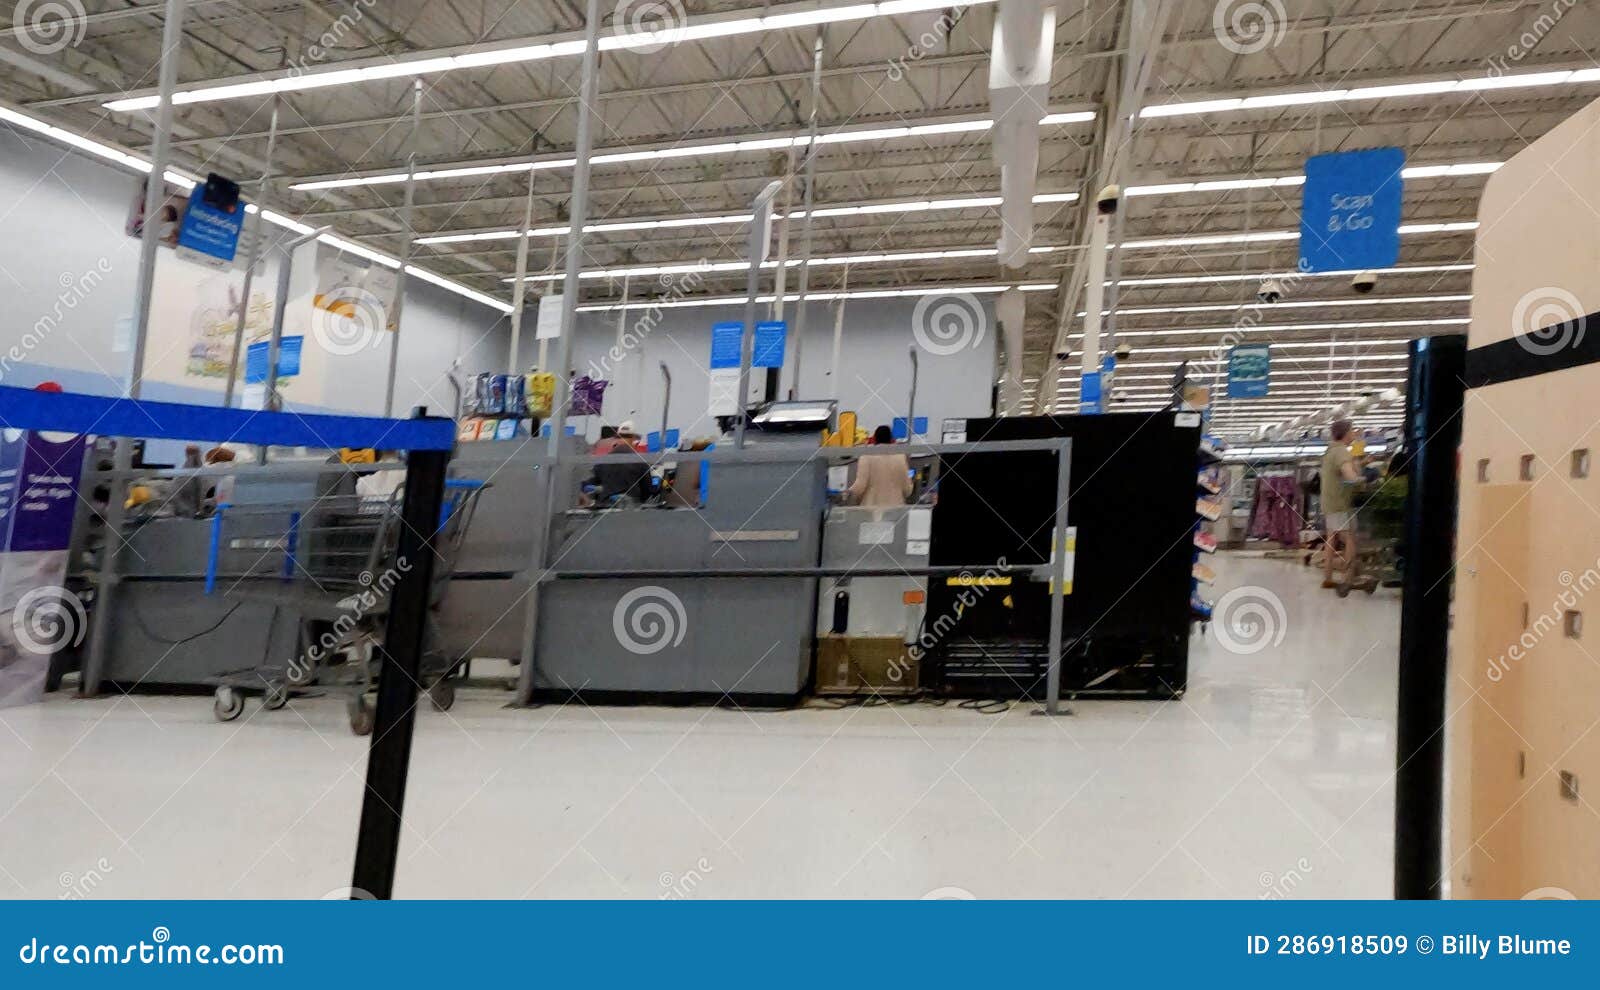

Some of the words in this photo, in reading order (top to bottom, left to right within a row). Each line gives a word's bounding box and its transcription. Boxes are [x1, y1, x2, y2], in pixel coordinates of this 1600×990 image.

[1330, 193, 1374, 211] Scan
[1327, 214, 1341, 231] &
[1345, 211, 1375, 230] Go
